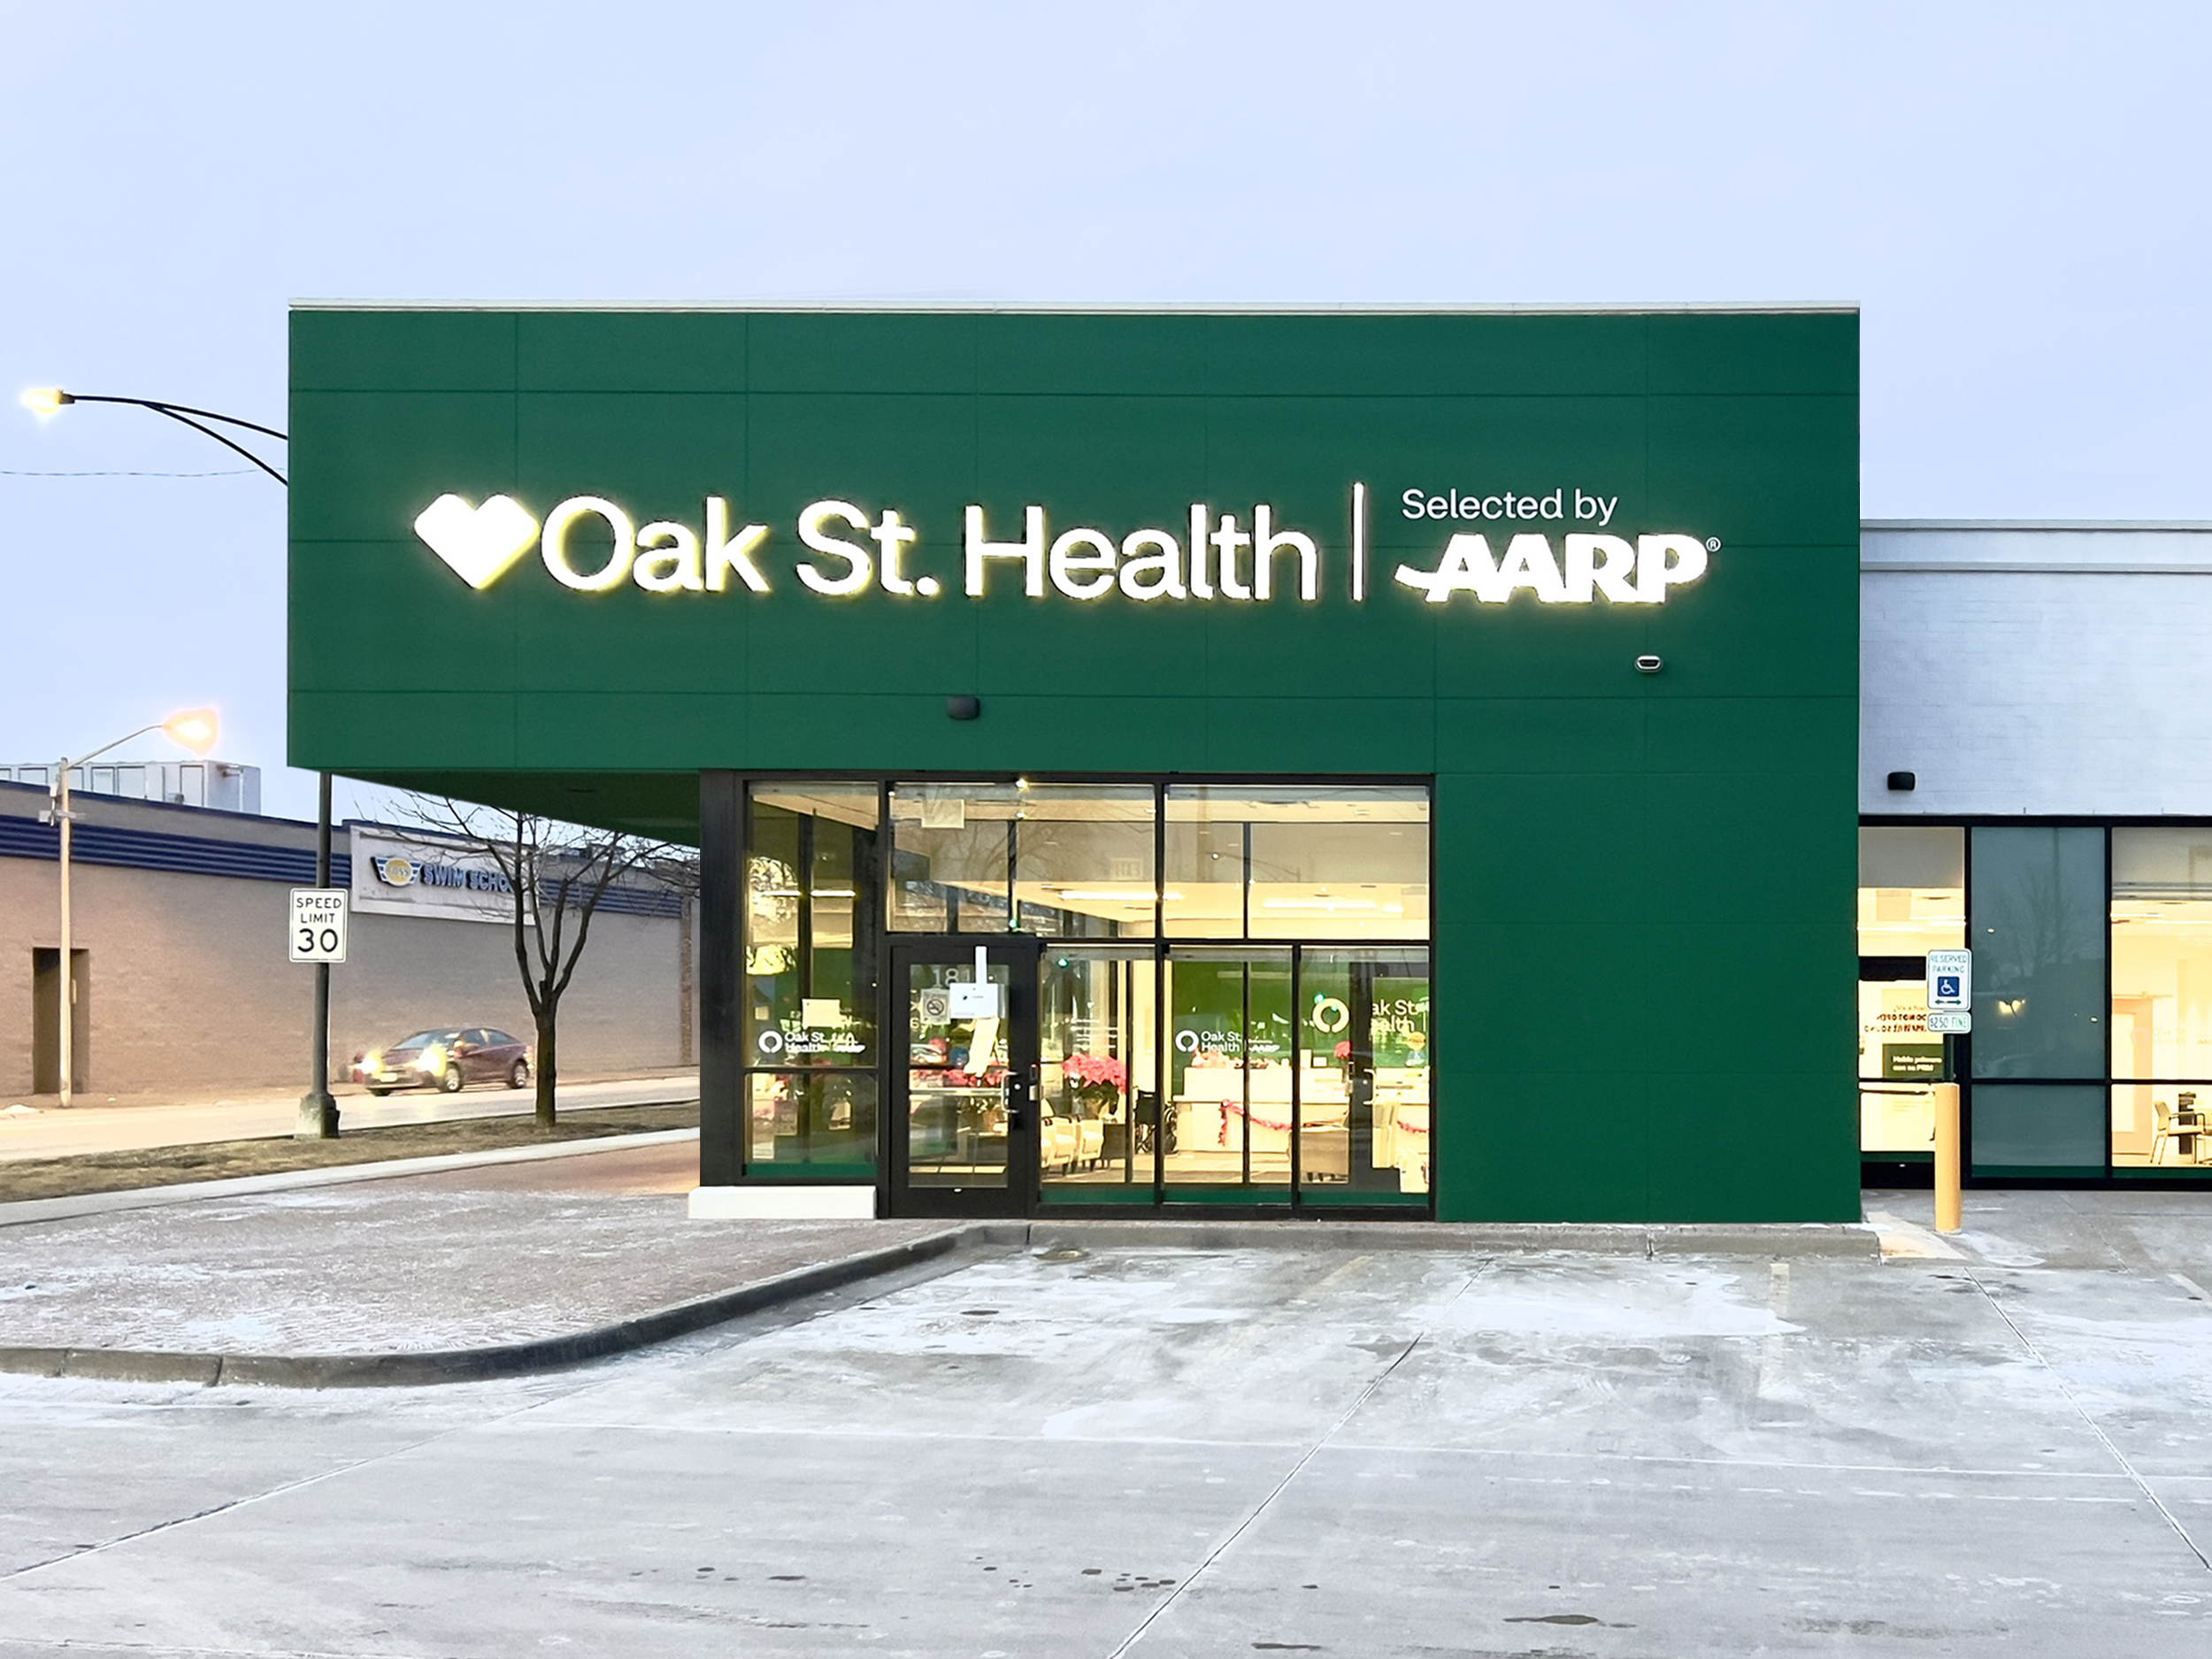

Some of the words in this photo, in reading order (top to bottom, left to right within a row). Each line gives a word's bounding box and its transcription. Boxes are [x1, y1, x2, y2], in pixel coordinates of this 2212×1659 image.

[1401, 488, 1564, 520] Selected
[1574, 488, 1619, 527] by
[541, 494, 772, 593] Oak
[795, 499, 940, 597] St.
[964, 503, 1317, 602] Health
[423, 865, 465, 887] SWIM
[296, 897, 342, 909] SPEED
[301, 913, 335, 924] LIMIT
[297, 927, 338, 953] 30
[1930, 955, 1967, 964] RESERVED
[1932, 965, 1965, 974] PARKING
[1930, 1017, 1949, 1029] $250
[1951, 1017, 1967, 1029] FINE
[785, 1032, 809, 1042] Oak
[1201, 1031, 1225, 1042] Oak
[1201, 1042, 1240, 1052] Health
